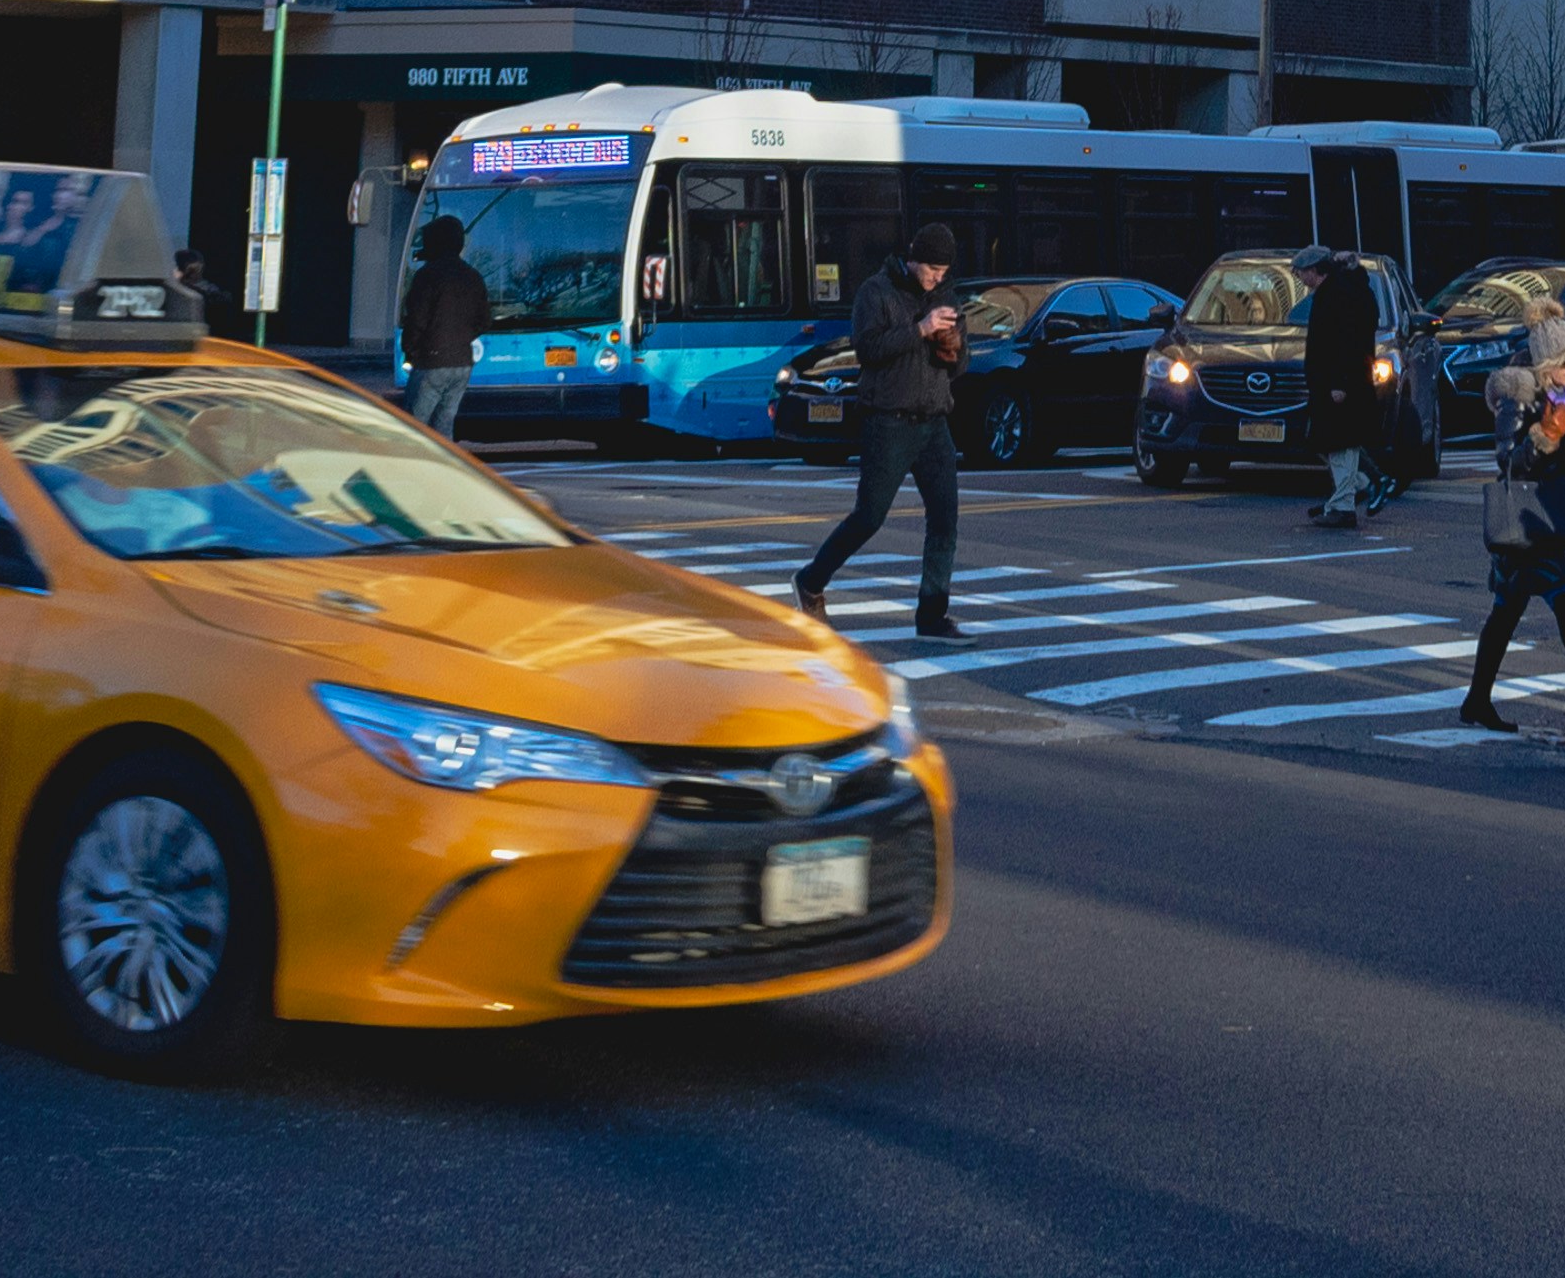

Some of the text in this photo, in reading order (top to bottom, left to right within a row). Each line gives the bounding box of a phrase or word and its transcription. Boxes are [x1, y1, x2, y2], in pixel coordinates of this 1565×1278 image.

[408, 66, 529, 87] 980 FIFTH AVE
[751, 129, 786, 147] 5838
